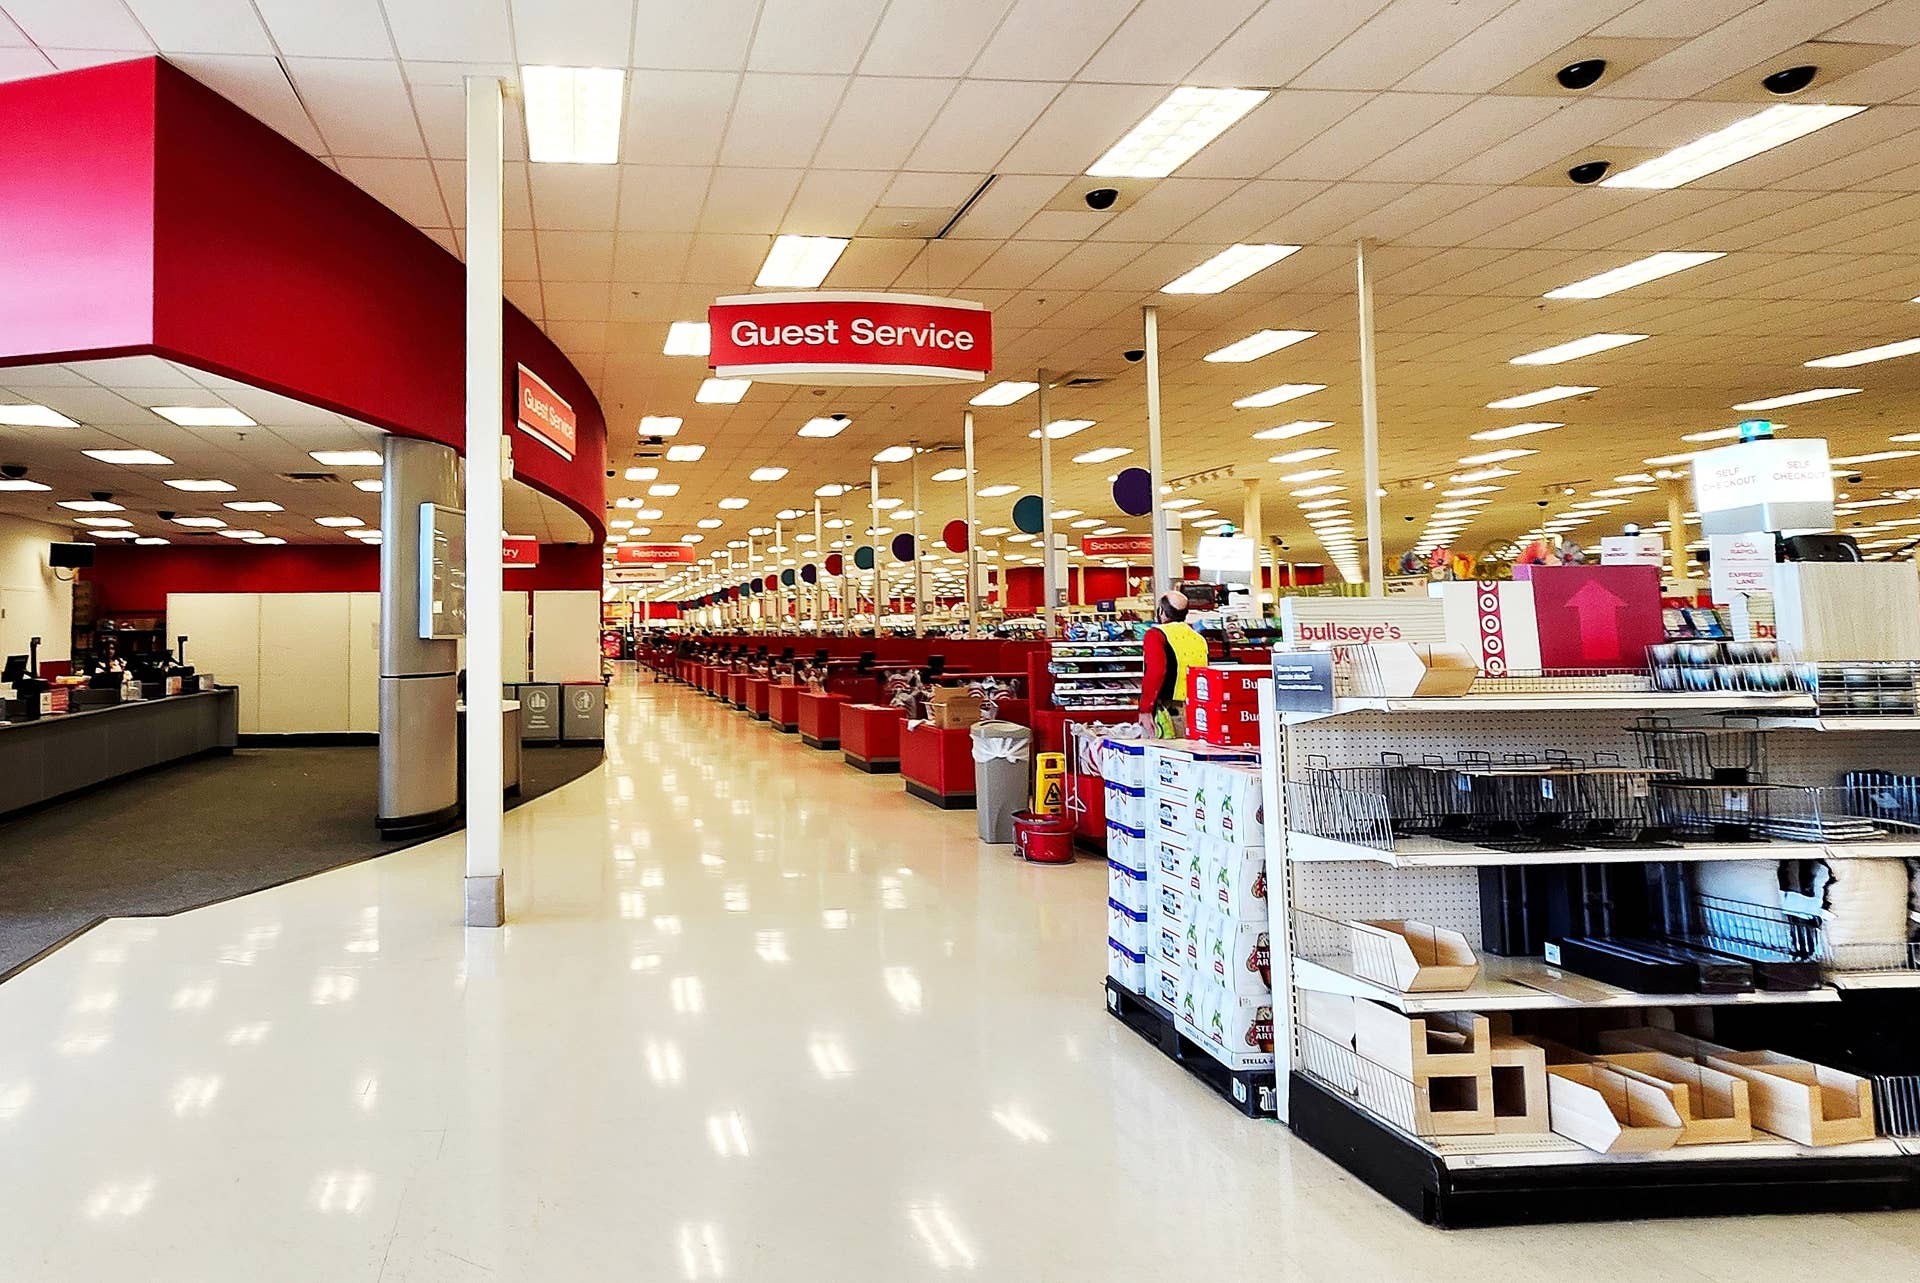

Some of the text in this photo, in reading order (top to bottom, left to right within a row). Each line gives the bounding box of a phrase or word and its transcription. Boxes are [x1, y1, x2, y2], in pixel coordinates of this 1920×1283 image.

[730, 318, 975, 351] Guest Service
[524, 387, 574, 440] Guest Service
[1715, 467, 1740, 478] SELF
[1787, 460, 1811, 469] SELF
[631, 549, 681, 558] Restroom
[1299, 622, 1401, 645] bullseye's
